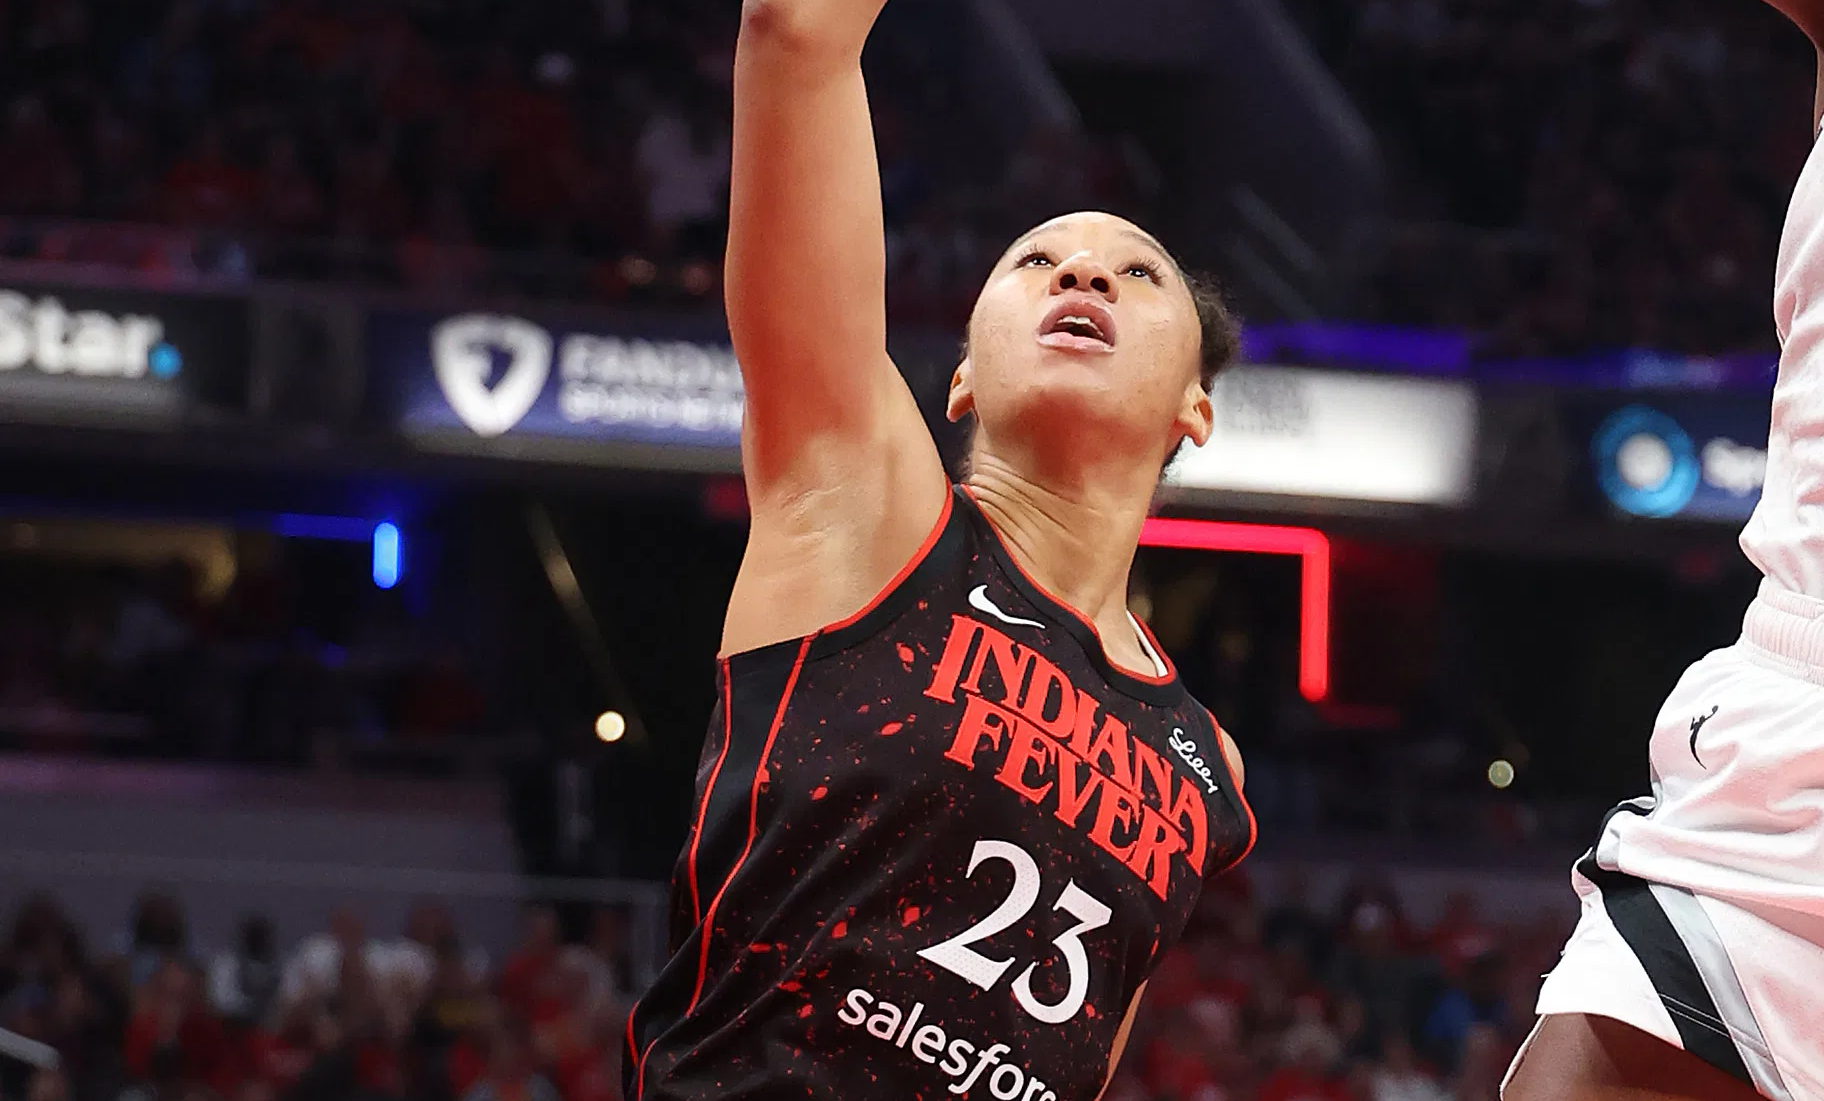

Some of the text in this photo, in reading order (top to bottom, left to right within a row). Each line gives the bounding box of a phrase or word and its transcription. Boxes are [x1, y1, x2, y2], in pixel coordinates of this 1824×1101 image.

[923, 614, 1209, 877] INDIANA
[944, 692, 1188, 902] FEVER
[1167, 727, 1219, 795] Lilly
[916, 840, 1113, 1024] 23
